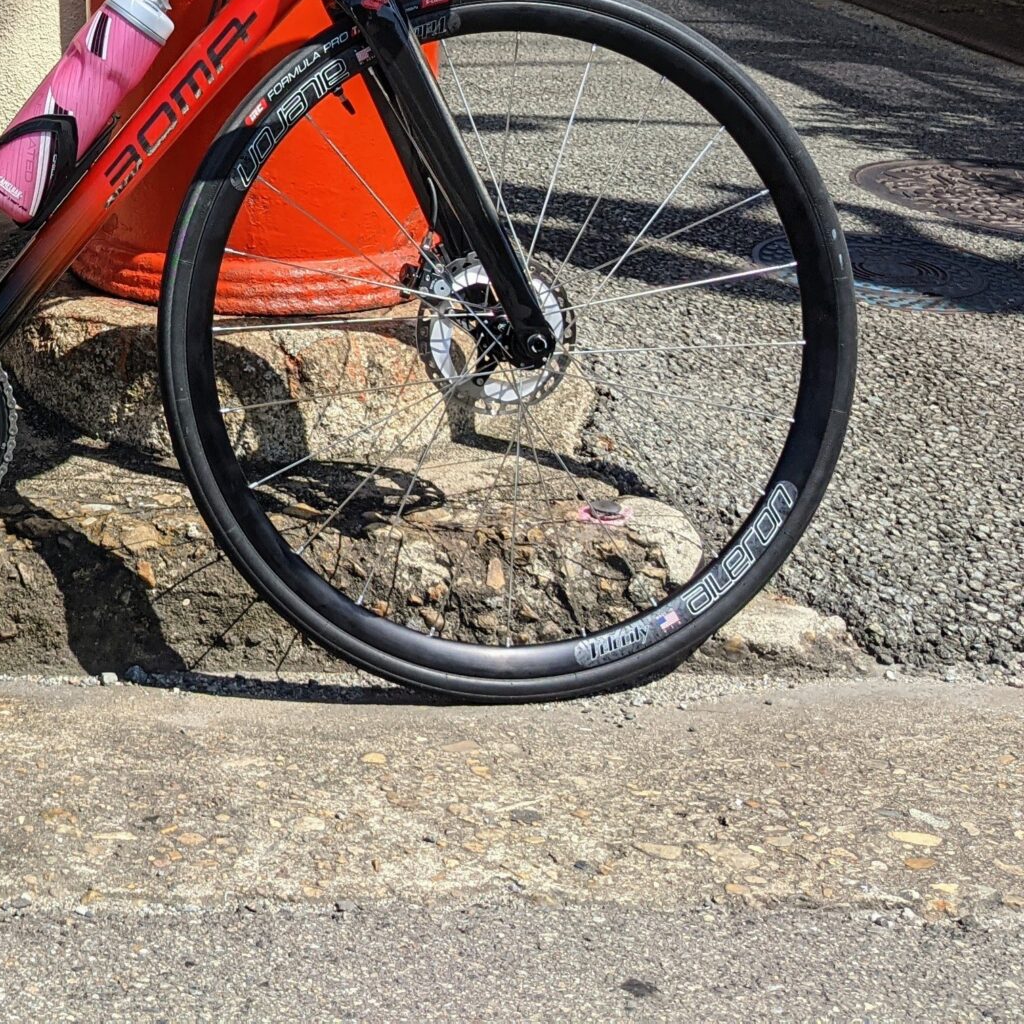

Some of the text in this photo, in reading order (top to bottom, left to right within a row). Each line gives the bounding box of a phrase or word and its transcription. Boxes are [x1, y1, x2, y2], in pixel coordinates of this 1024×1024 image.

[236, 57, 350, 189] aileron
[266, 51, 322, 102] FORMULA
[323, 31, 350, 55] PRO
[680, 482, 794, 616] aileron
